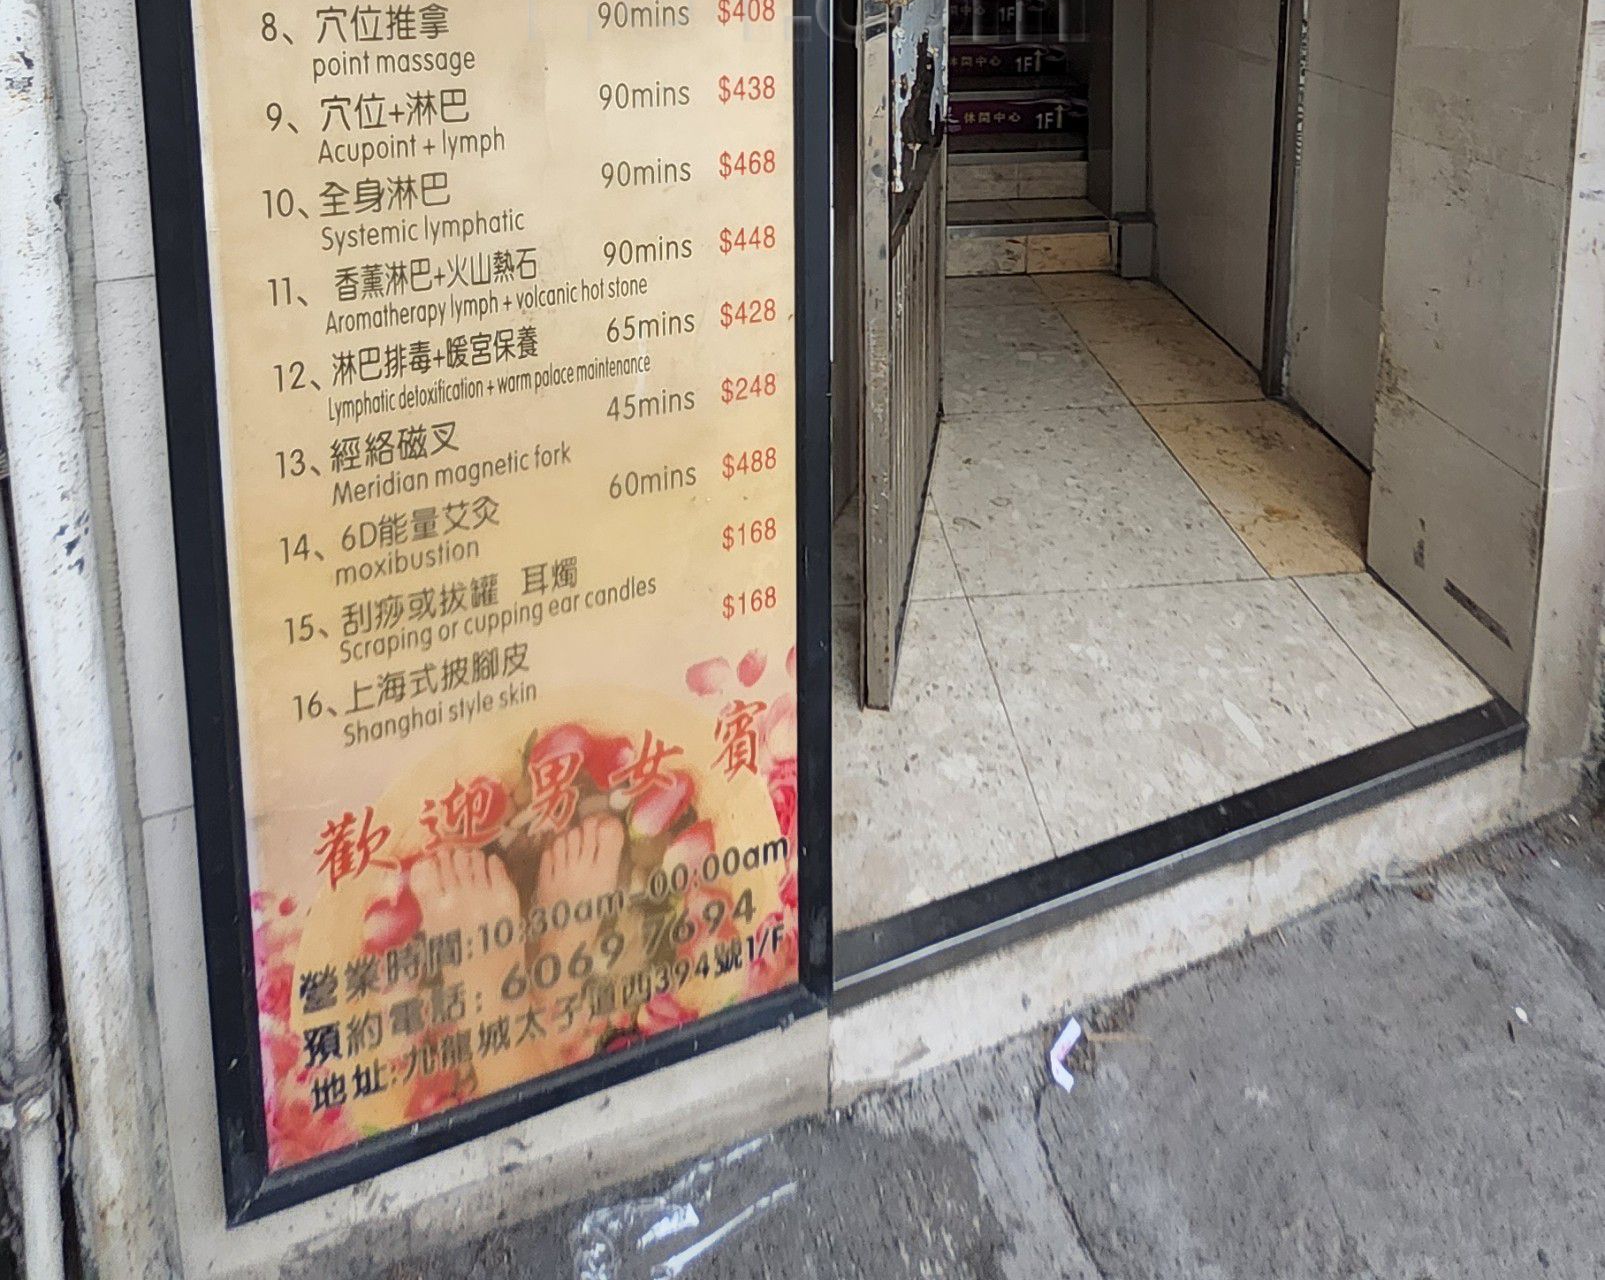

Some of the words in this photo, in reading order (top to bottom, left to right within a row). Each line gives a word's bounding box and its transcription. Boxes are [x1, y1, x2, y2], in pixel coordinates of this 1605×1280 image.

[316, 2, 449, 45] 穴位推拿
[598, 1, 690, 29] 90mins
[312, 51, 370, 84] point
[376, 49, 476, 77] massage
[1016, 55, 1033, 73] 1F
[320, 88, 469, 132] 穴位+淋巴
[598, 81, 690, 110] 90mins
[718, 75, 776, 104] $438
[1036, 112, 1054, 130] 1F
[318, 134, 417, 166] Acupoint
[423, 140, 436, 156] +
[441, 126, 506, 159] lymph
[600, 159, 691, 189] 90mins
[718, 149, 776, 180] $468
[319, 171, 451, 219] 全身淋巴
[321, 219, 419, 256] Systemic
[423, 210, 525, 242] lymphatic
[603, 236, 693, 267] 90mins
[719, 224, 777, 255] $448
[334, 248, 538, 302] 香薰淋巴+火山熱石
[325, 301, 446, 335] Aromatherapy
[450, 290, 499, 322] lymph
[502, 298, 513, 312] +
[516, 281, 578, 310] volcanic
[581, 275, 605, 300] hot
[608, 275, 648, 298] stone
[606, 310, 695, 344] 65mins
[719, 298, 777, 329] $428
[332, 325, 539, 386] 淋巴排毒+暖宮保養
[328, 384, 396, 428] Lymphatic
[399, 373, 484, 410] detoxification
[487, 380, 494, 396] +
[499, 370, 532, 394] warm
[534, 361, 574, 396] palace
[576, 353, 651, 383] maintenance
[606, 386, 695, 422] 45mins
[720, 373, 777, 405] $248
[330, 420, 459, 476] 經絡磁叉
[332, 469, 429, 507] Meridian
[434, 454, 528, 490] magnetic
[534, 440, 572, 469] fork
[608, 463, 697, 500] 60mins
[721, 447, 777, 481] $488
[341, 495, 500, 553] 6D能量艾灸
[721, 517, 777, 551] $168
[335, 539, 479, 587] moxibustion
[339, 626, 432, 665] Scraping
[438, 620, 457, 641] or
[463, 600, 543, 635] cupping
[548, 594, 579, 617] ear
[584, 572, 657, 610] candles
[341, 572, 499, 638] 刮痧或拔罐
[721, 585, 777, 619] $168
[344, 642, 529, 716] 上海式披腳皮
[343, 701, 442, 748] Shanghai
[449, 691, 493, 722] style
[499, 680, 537, 710] skin
[314, 699, 768, 893] 歡迎男女賓
